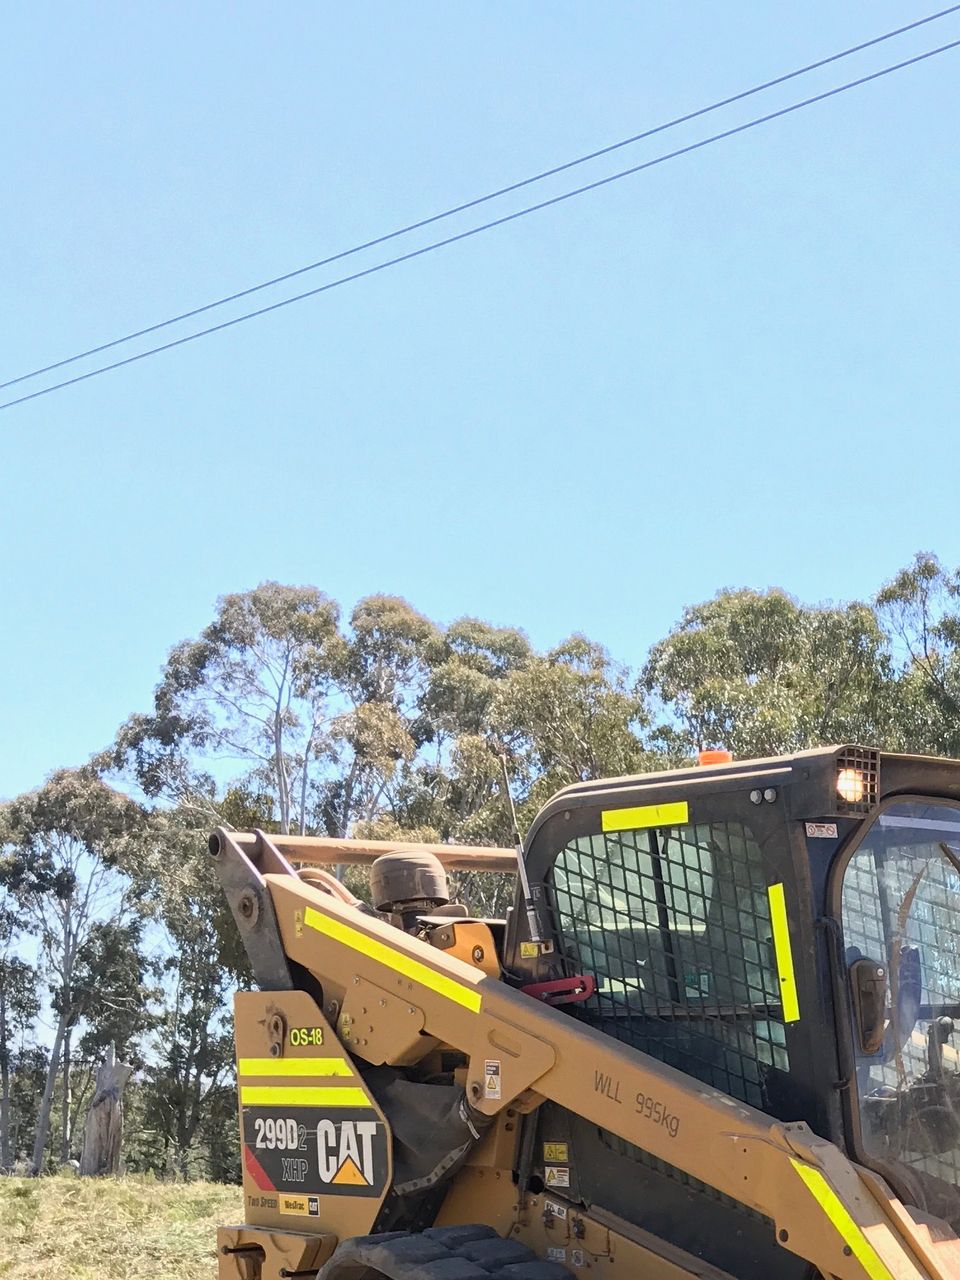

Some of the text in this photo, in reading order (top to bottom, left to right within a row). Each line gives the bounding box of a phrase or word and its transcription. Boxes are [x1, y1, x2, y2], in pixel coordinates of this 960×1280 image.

[290, 1028, 323, 1046] OS-18
[594, 1070, 680, 1137] WLL 995kg
[281, 1157, 309, 1182] XHP
[316, 1119, 377, 1186] CAT
